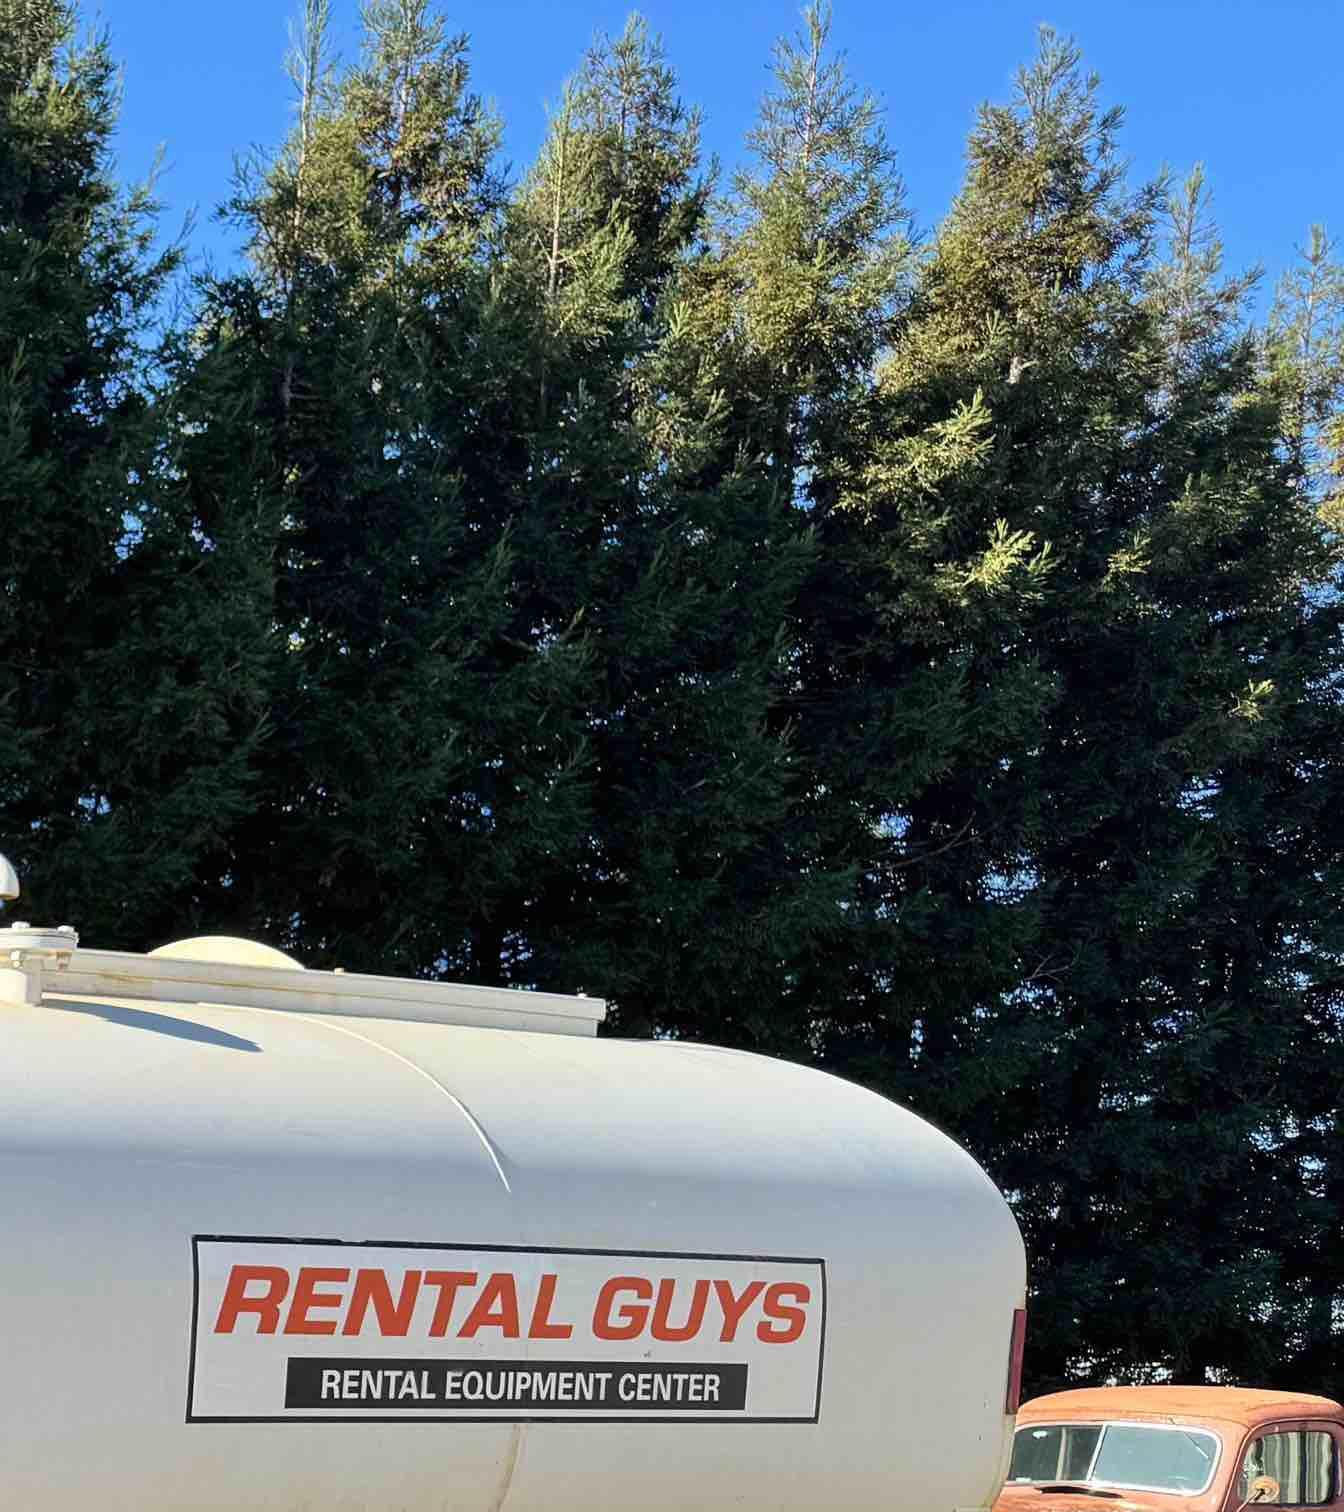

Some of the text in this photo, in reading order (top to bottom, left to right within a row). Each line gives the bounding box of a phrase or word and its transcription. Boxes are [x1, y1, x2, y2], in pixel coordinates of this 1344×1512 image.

[214, 1264, 812, 1345] RENTAL GUYS
[320, 1368, 721, 1402] RENTAL EQUIPMENT CENTER
